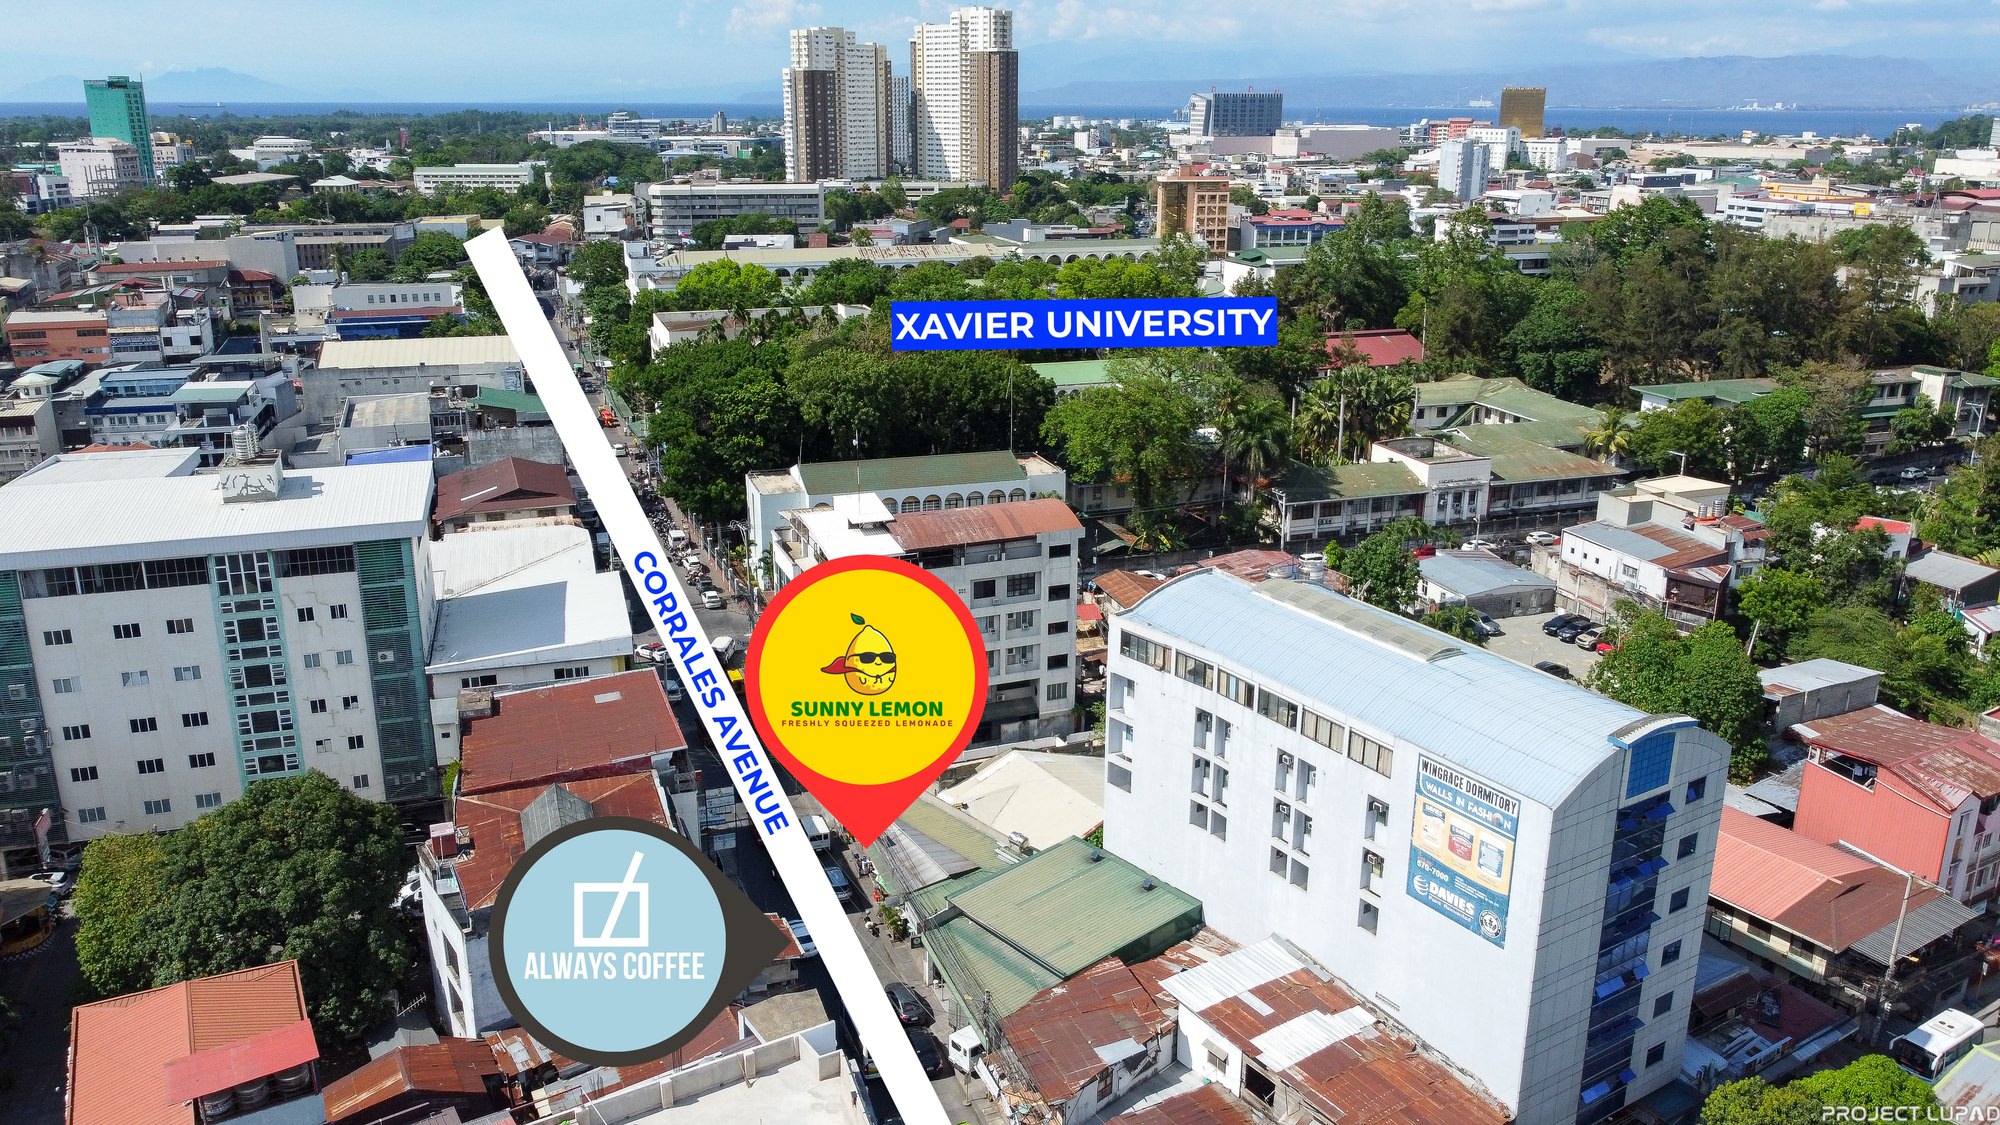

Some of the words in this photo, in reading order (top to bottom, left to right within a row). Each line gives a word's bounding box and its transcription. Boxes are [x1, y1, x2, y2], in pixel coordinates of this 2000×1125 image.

[1421, 758, 1464, 790] WINGRACE
[1465, 780, 1517, 815] DORMITORY
[1425, 781, 1453, 801] WALLS
[1456, 795, 1465, 808] IN
[1467, 801, 1511, 830] FASHION
[1429, 881, 1475, 916] DAVIES
